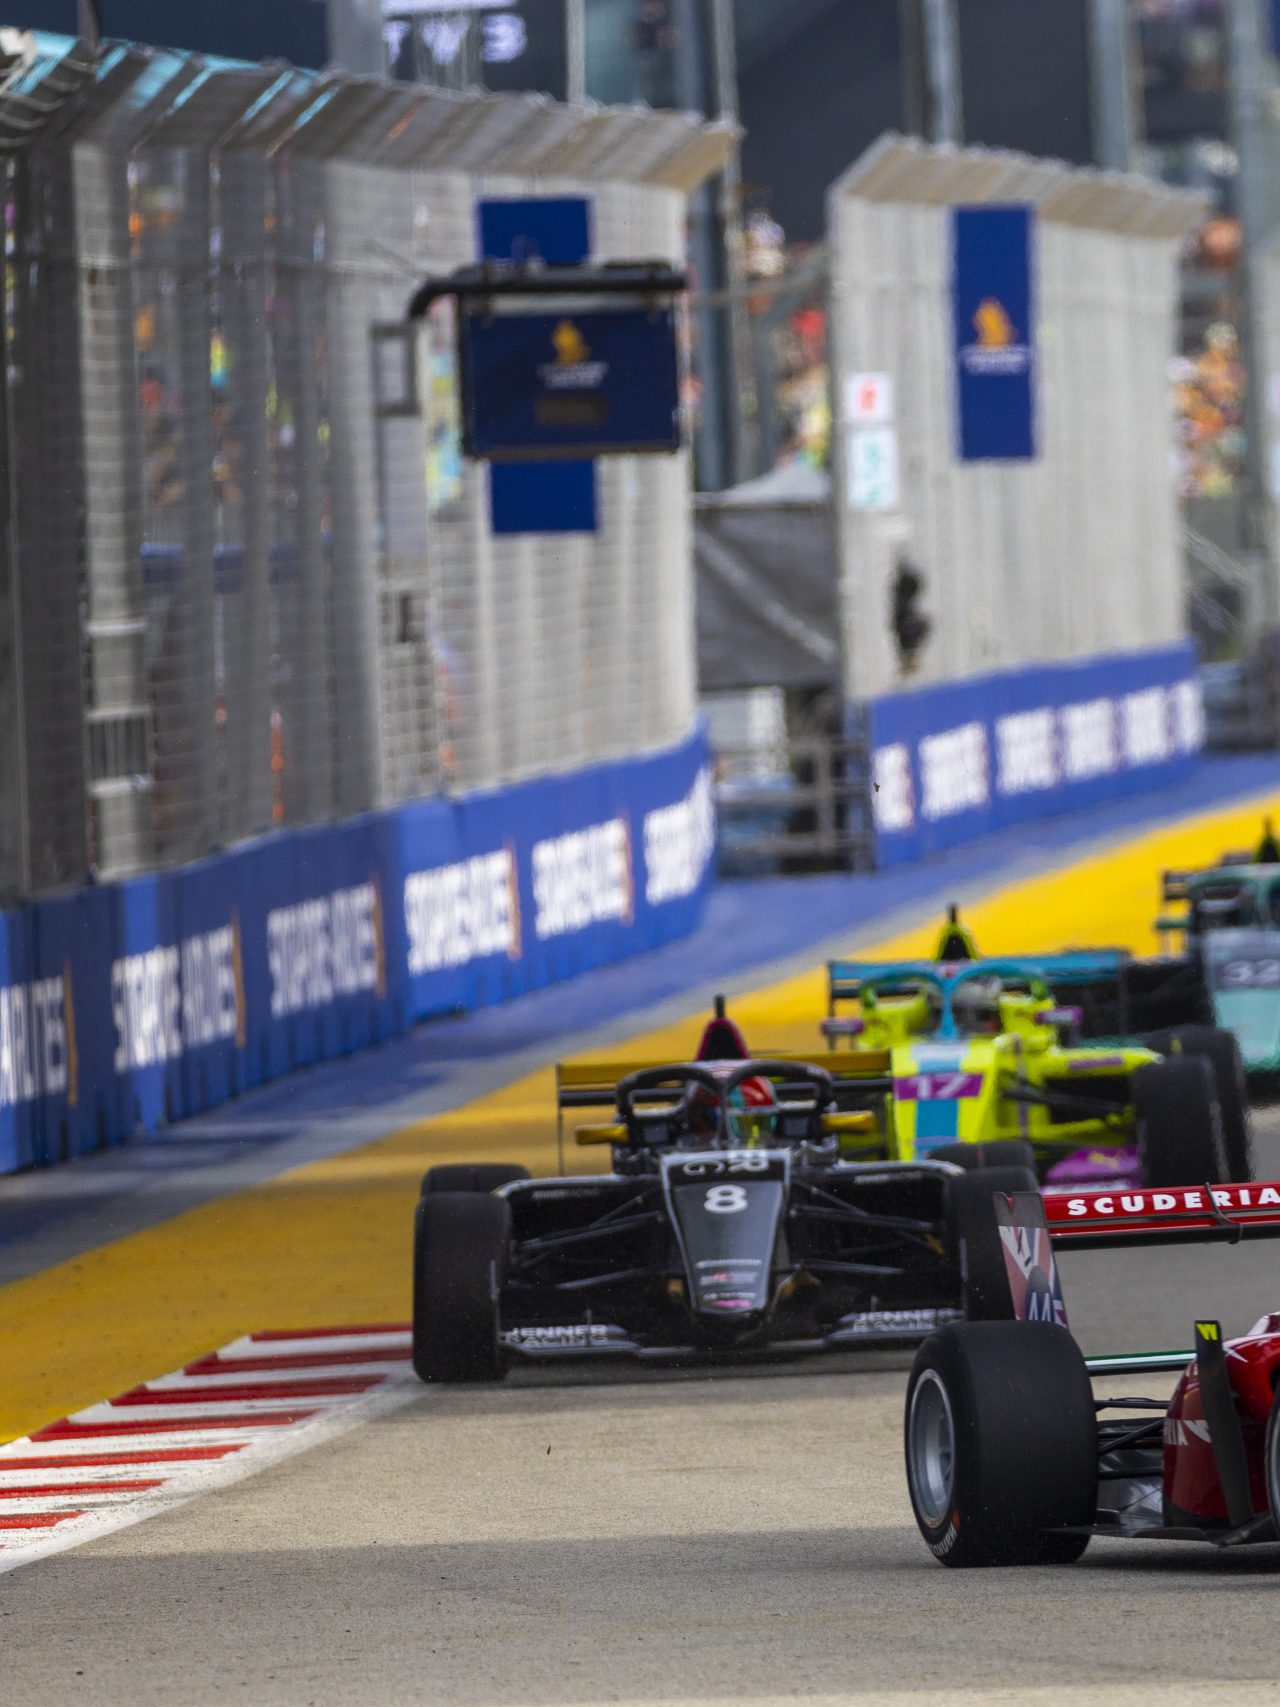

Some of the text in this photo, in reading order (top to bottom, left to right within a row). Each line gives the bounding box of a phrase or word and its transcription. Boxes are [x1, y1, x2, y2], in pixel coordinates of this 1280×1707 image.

[912, 1075, 968, 1100] 17
[704, 1184, 748, 1214] 8
[513, 1325, 608, 1338] JENNER
